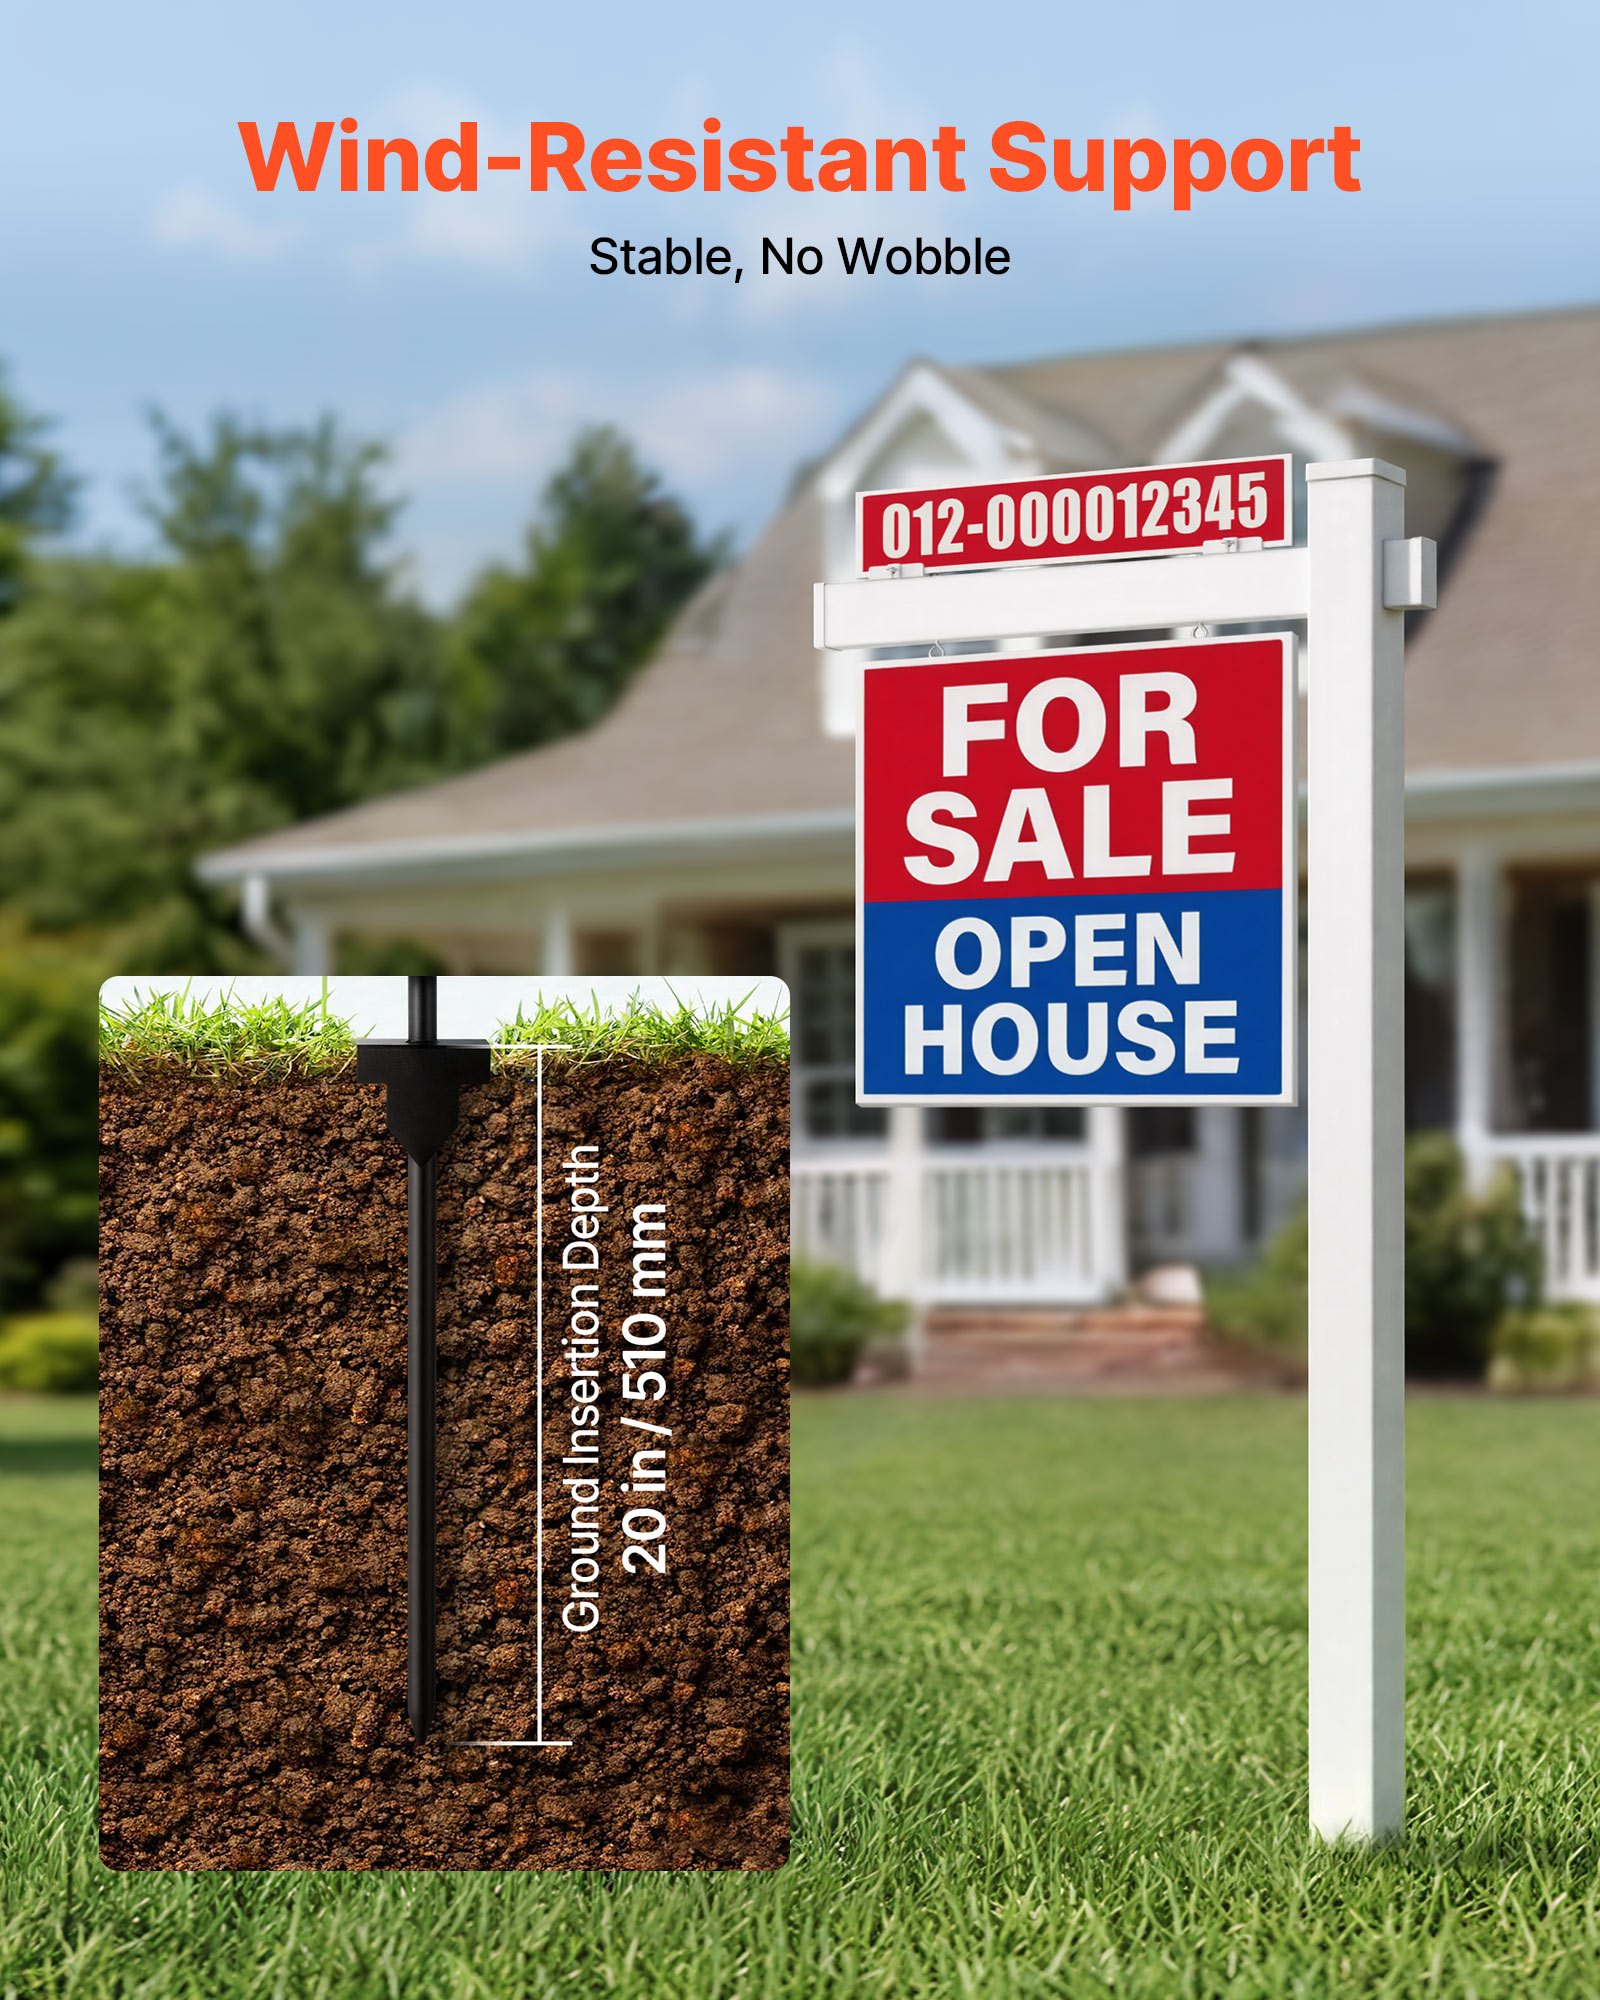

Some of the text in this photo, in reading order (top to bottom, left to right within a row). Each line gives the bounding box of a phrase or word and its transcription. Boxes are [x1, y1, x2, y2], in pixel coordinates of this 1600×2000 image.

[882, 472, 1268, 559] 012-000012345
[942, 671, 1197, 777] FOR
[904, 778, 1236, 885] SALE
[935, 911, 1201, 990] OPEN
[904, 1000, 1239, 1075] HOUSE
